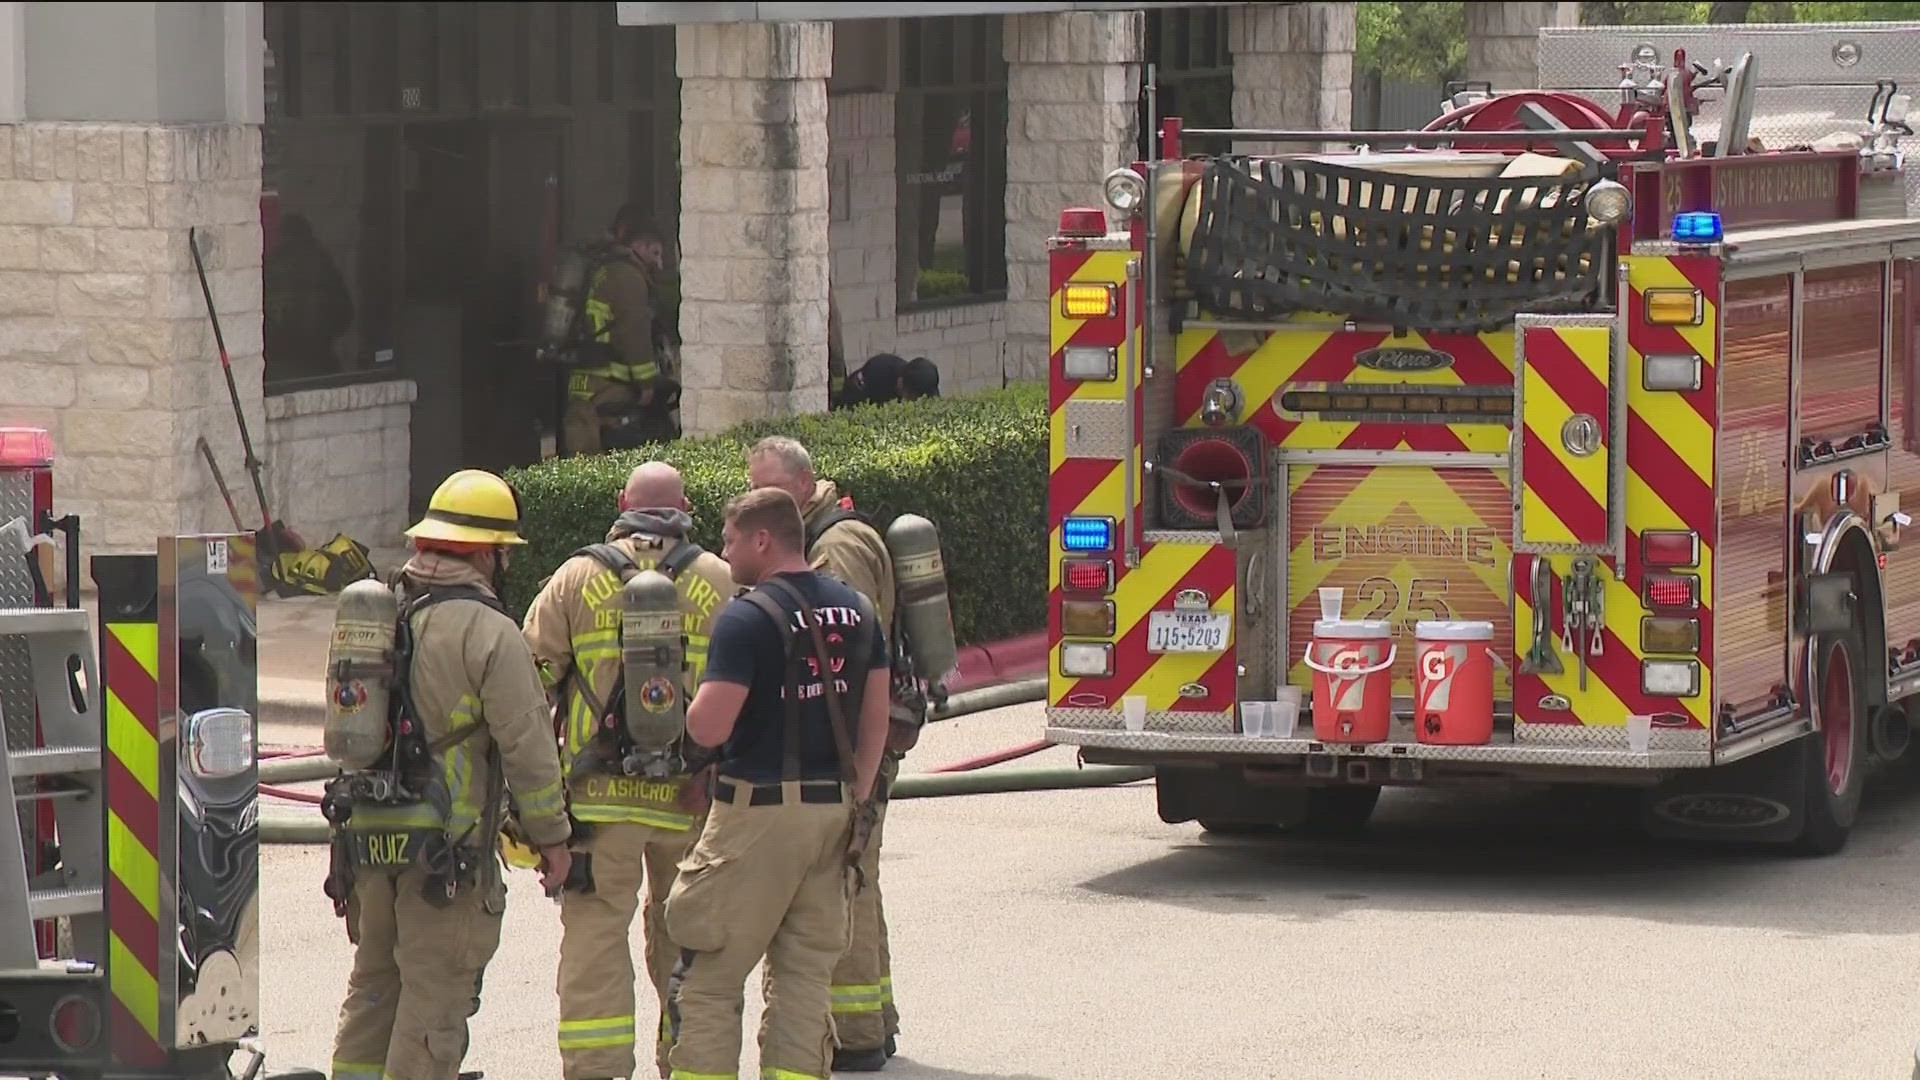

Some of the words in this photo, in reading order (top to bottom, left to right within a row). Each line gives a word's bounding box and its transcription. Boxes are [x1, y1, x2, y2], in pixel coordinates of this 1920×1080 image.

[402, 88, 421, 108] 200
[1667, 175, 1682, 213] 25
[1749, 167, 1773, 205] FIRE
[1777, 162, 1840, 203] DEPARTMENT
[1375, 351, 1431, 368] Pierce
[1311, 523, 1497, 568] ENGINE
[1176, 615, 1208, 624] TEXAS
[1357, 575, 1452, 637] 25
[1334, 650, 1360, 681] G
[1423, 650, 1446, 681] G
[586, 778, 603, 797] C.
[368, 832, 410, 865] RUIZ
